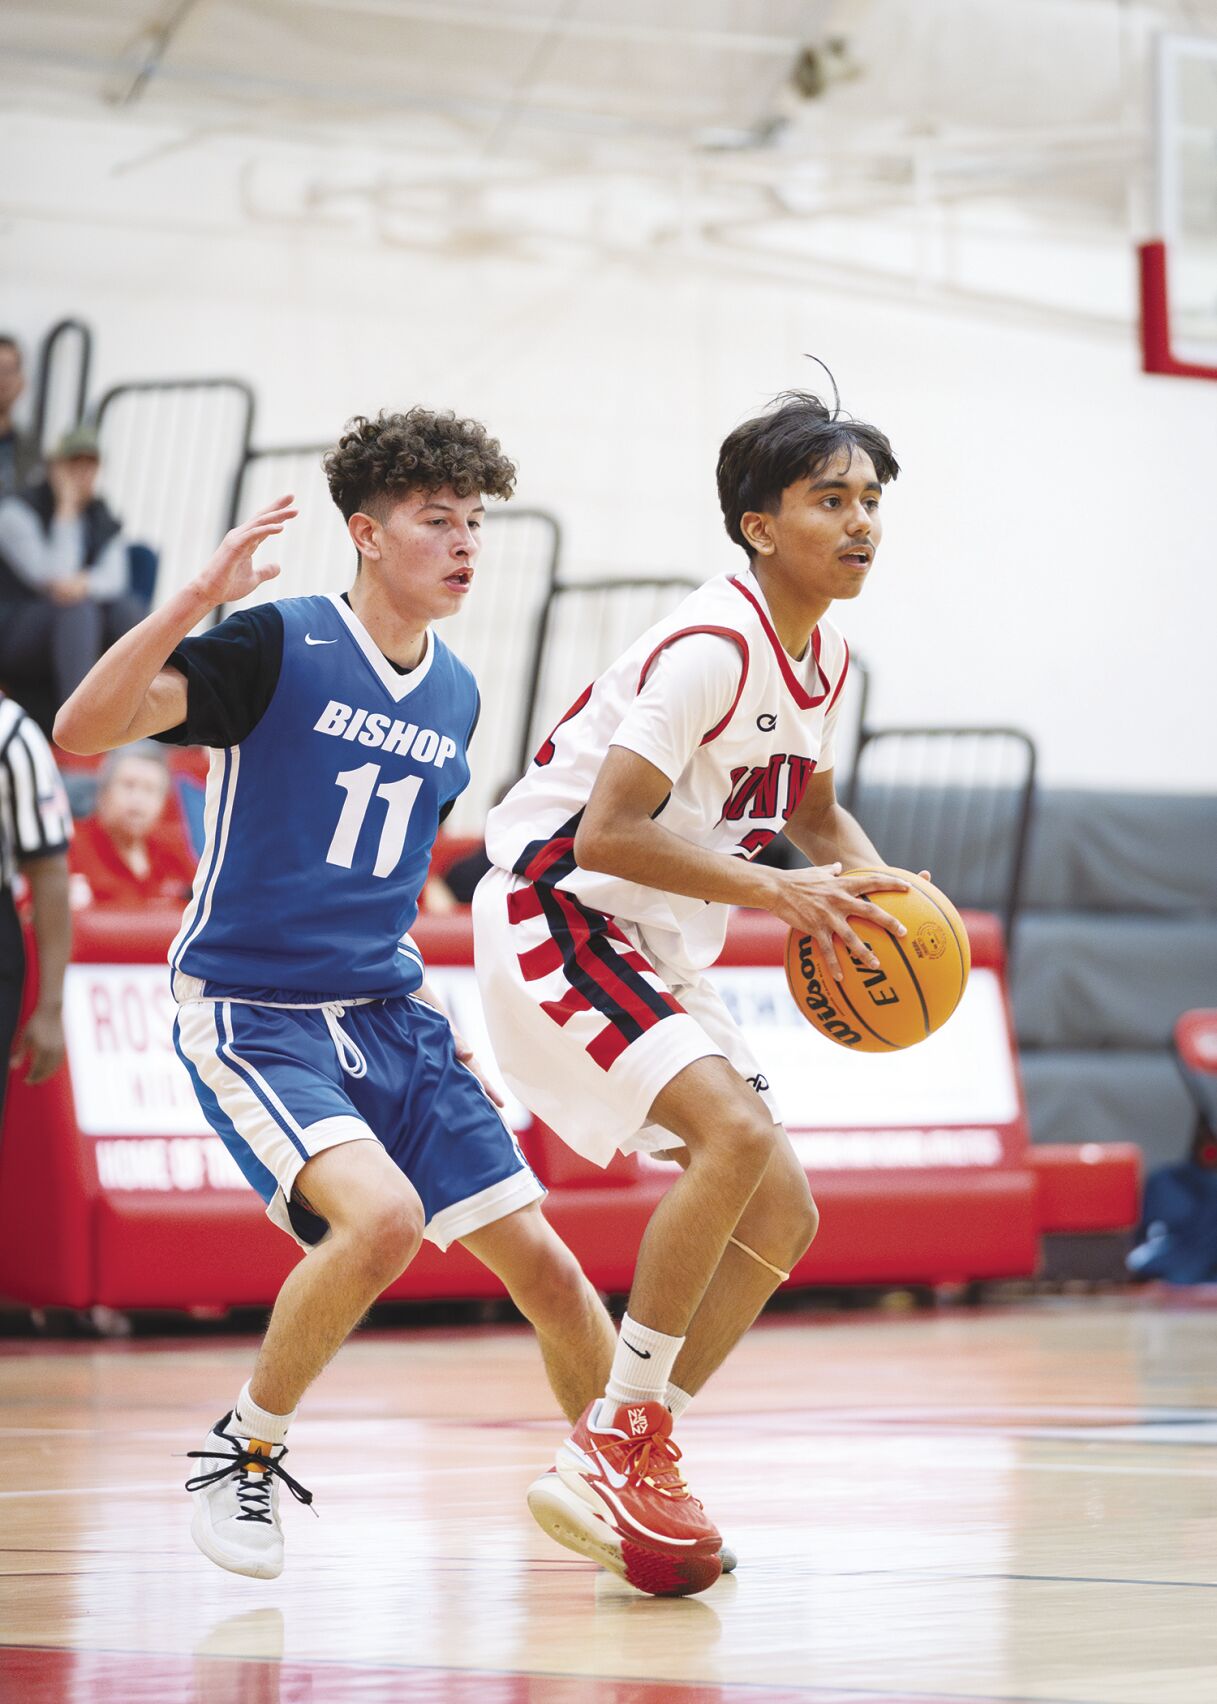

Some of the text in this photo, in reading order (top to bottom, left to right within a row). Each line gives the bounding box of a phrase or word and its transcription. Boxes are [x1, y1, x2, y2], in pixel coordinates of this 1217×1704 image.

[313, 700, 457, 768] BISHOP
[326, 762, 424, 879] 11
[798, 935, 863, 1047] Wilson
